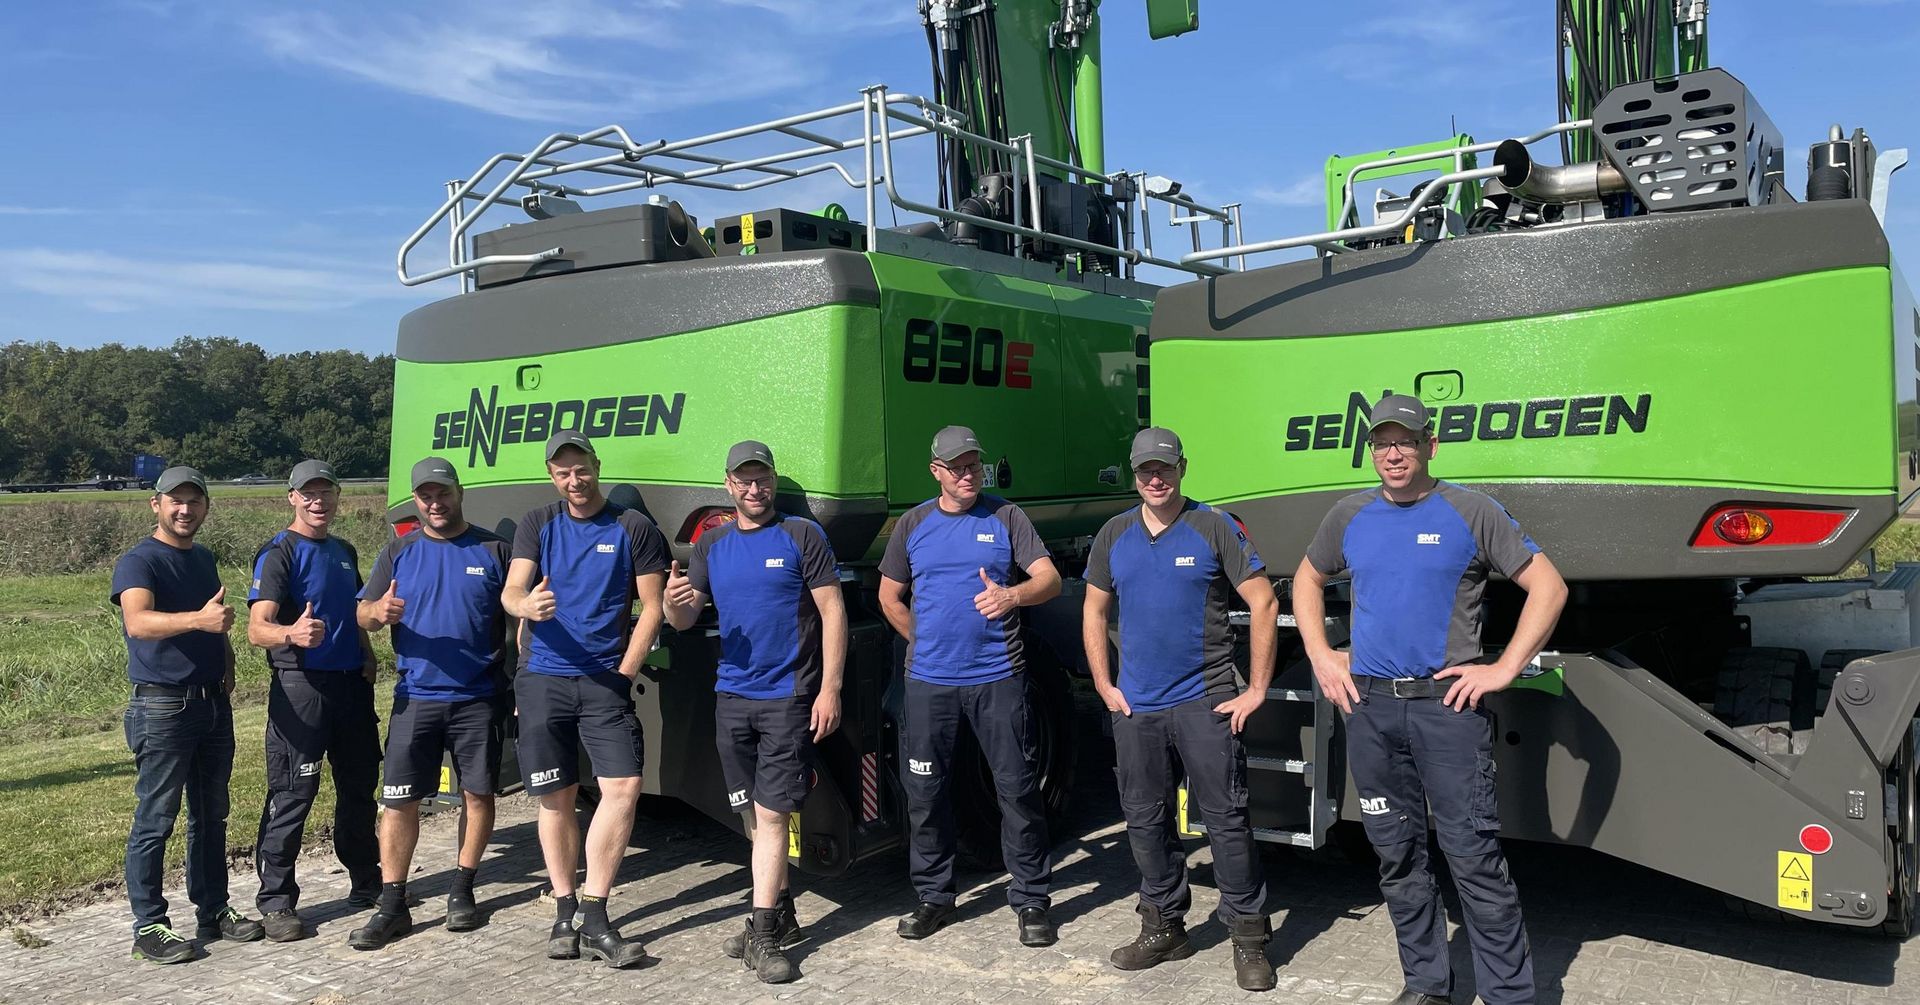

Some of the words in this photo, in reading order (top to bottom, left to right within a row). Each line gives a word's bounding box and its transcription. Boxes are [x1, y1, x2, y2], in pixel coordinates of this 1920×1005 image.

[902, 317, 1035, 390] 830E
[432, 384, 687, 468] SENNEBOGEN
[1417, 533, 1441, 543] SMT
[1174, 556, 1195, 565] SMT
[909, 758, 932, 773] SMT
[530, 768, 559, 784] SMT
[383, 784, 411, 796] SMT
[728, 789, 746, 804] MT
[1359, 797, 1387, 812] SMT
